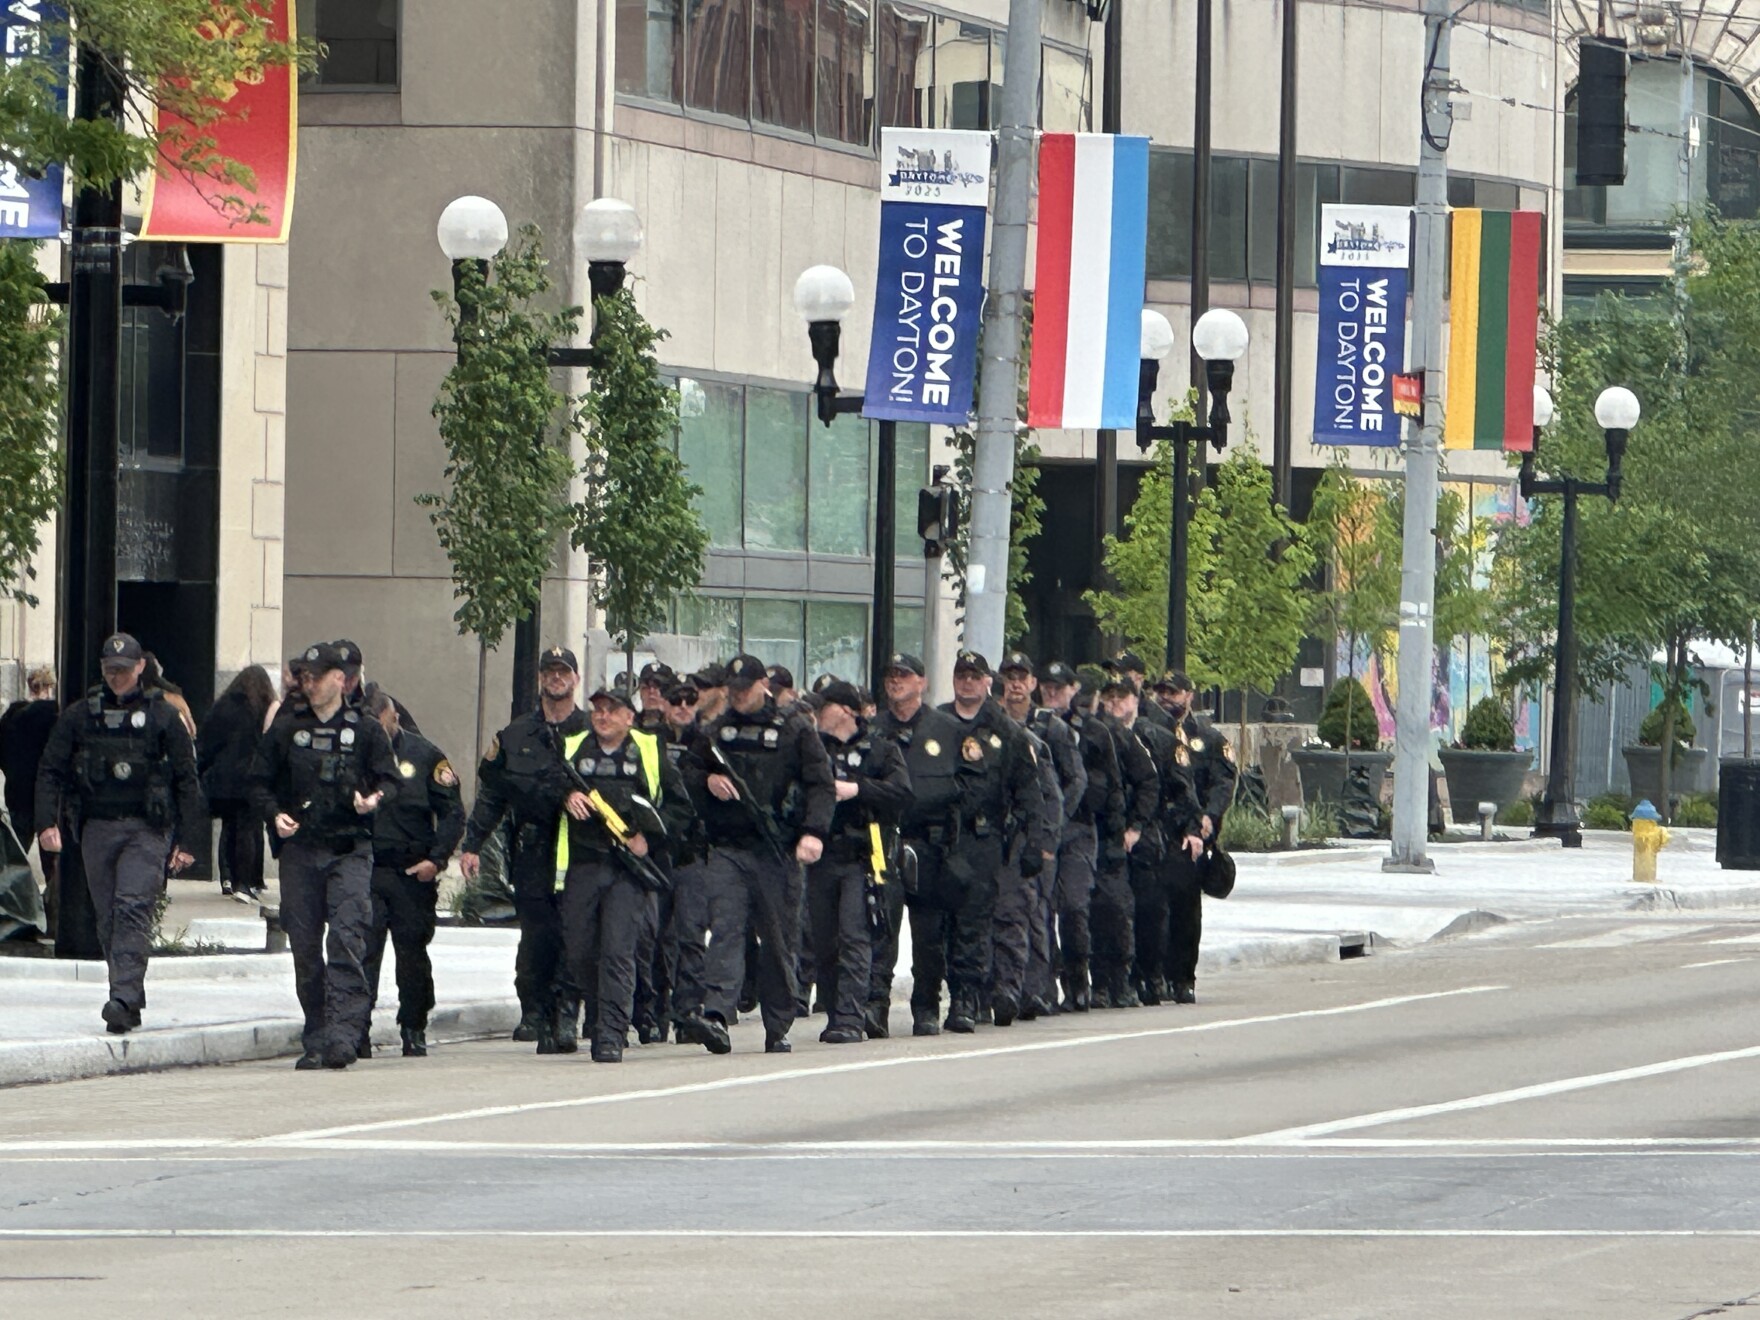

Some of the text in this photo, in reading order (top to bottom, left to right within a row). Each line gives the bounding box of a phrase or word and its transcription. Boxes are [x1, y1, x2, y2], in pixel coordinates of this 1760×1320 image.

[888, 217, 928, 403] TO DAYTON!
[920, 218, 963, 407] WELCOME
[1339, 278, 1360, 312] TO
[1360, 278, 1389, 432] WELCOME
[1334, 321, 1359, 430] DAYTON!
